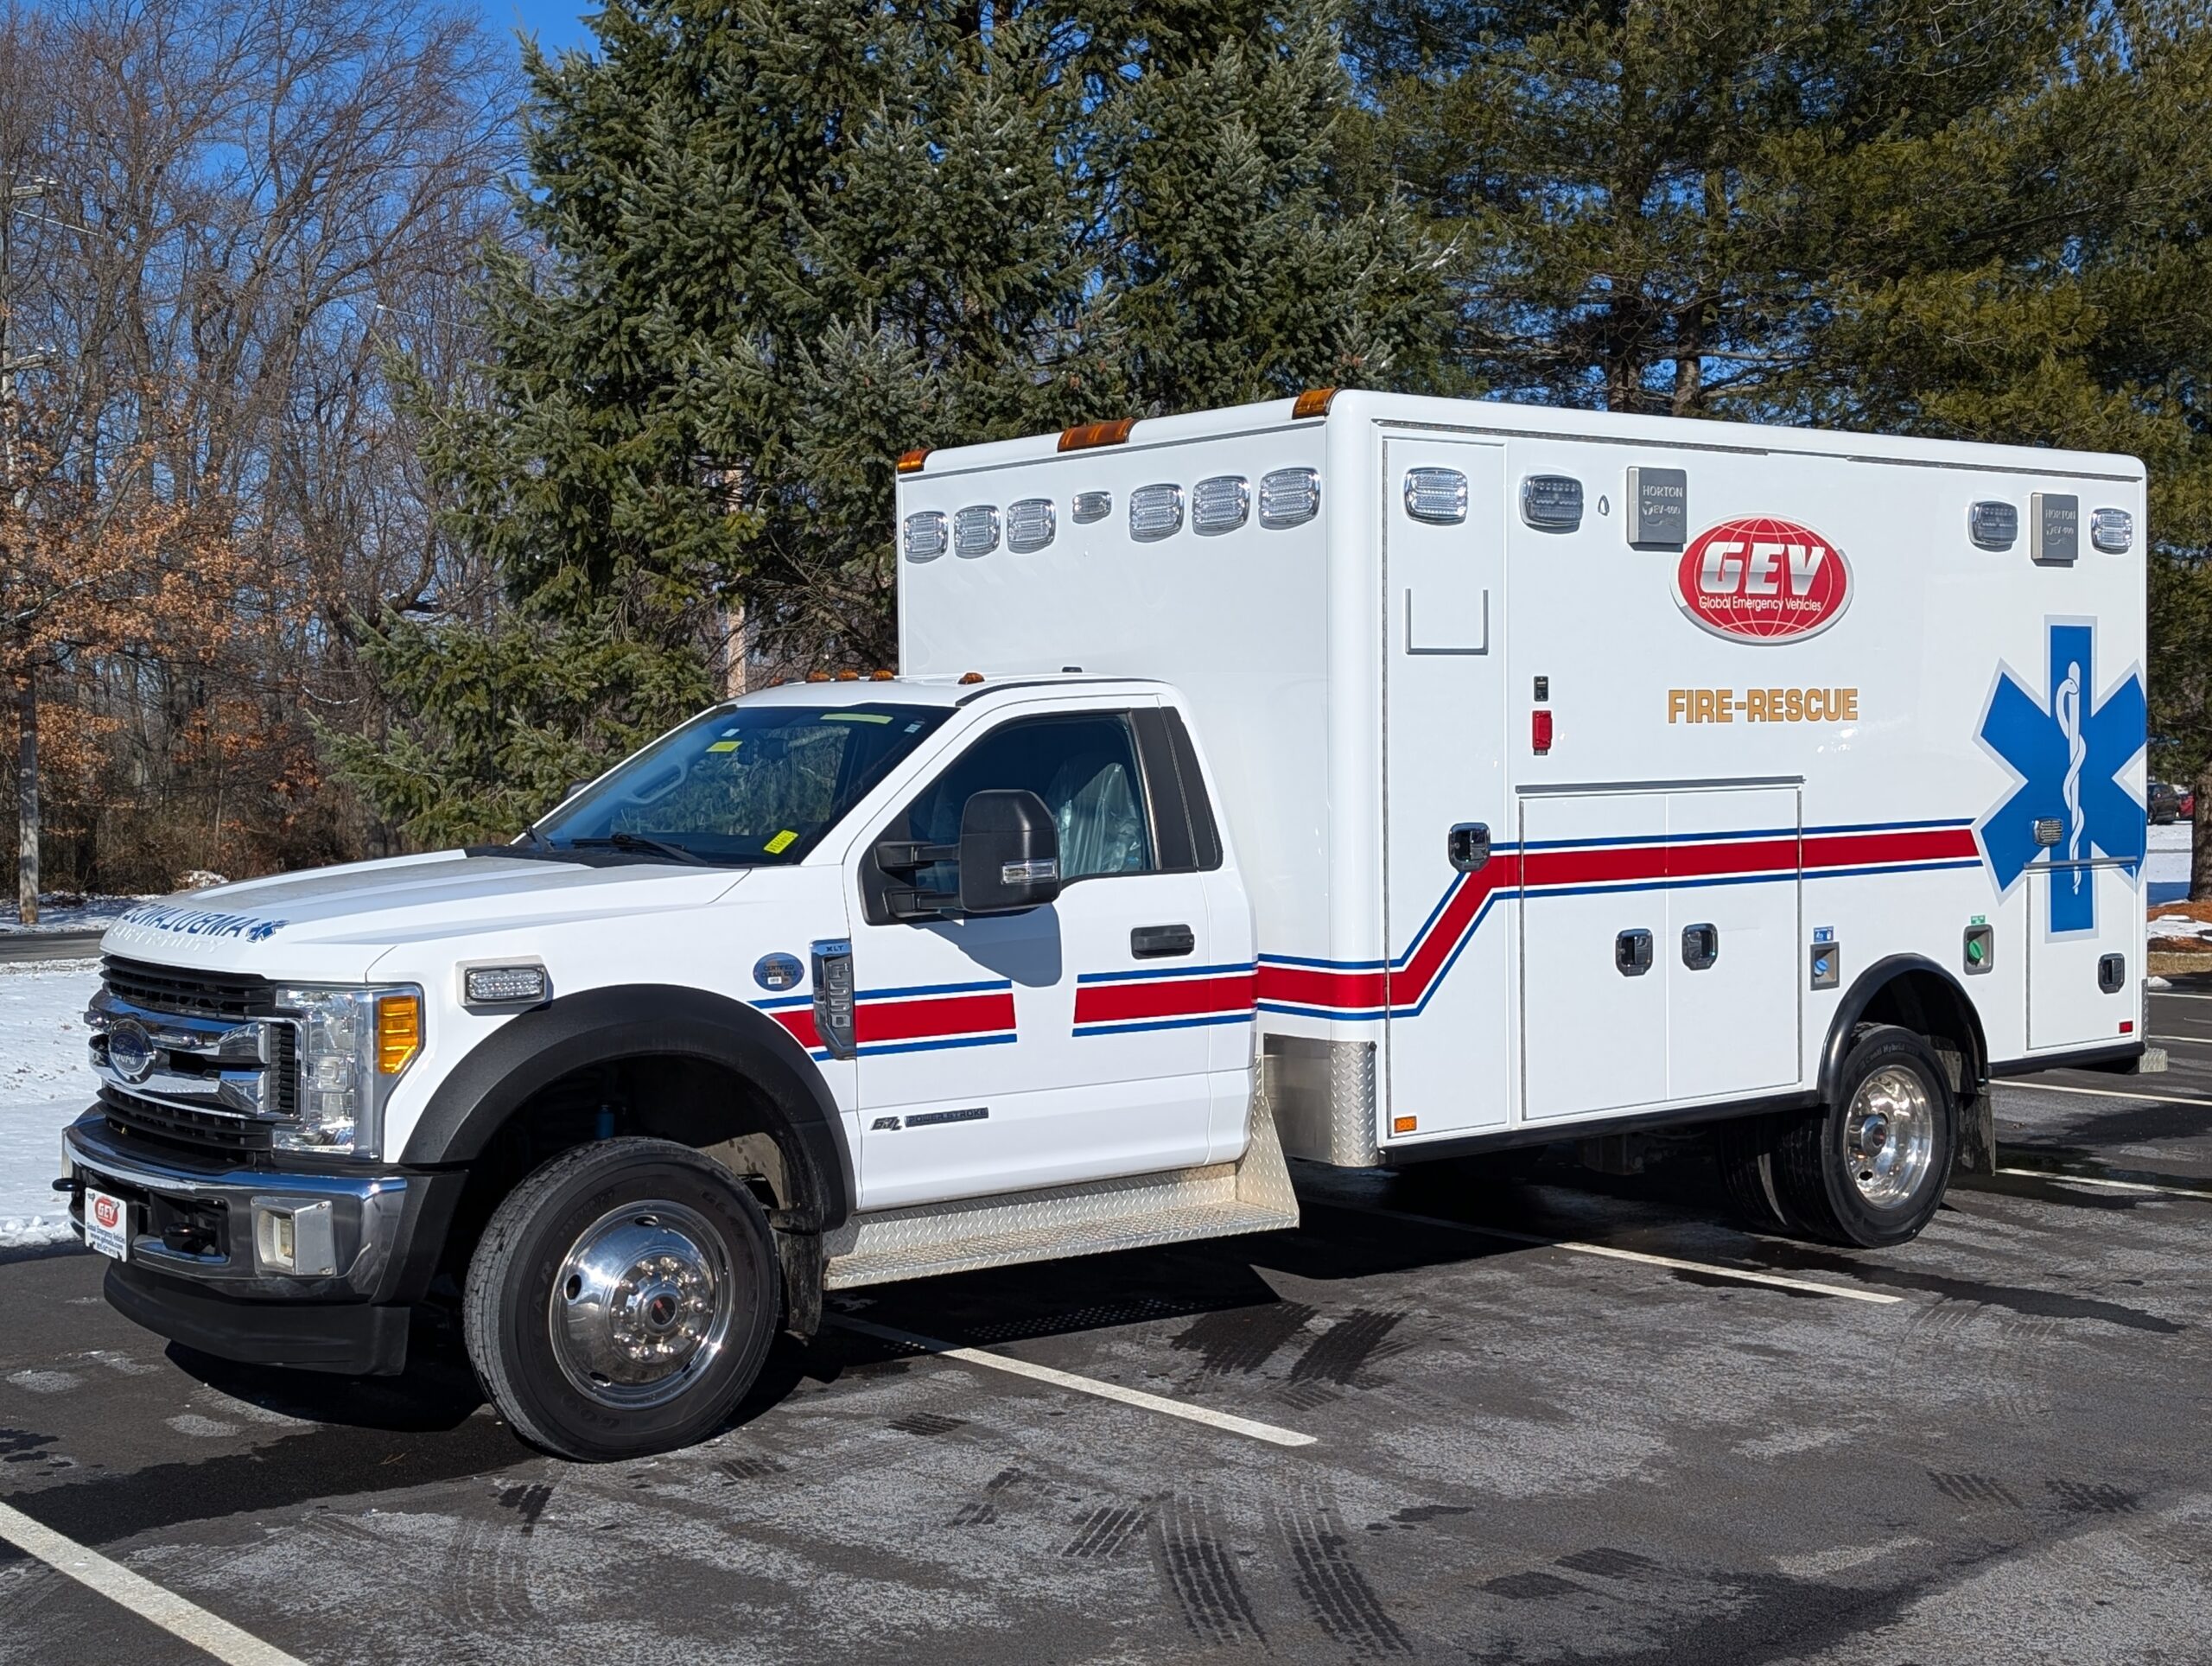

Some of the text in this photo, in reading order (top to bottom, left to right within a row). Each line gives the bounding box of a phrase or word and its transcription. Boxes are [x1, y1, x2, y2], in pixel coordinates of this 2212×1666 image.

[1643, 485, 1683, 498] HORTON
[2045, 508, 2076, 520] HORTON
[1700, 541, 1826, 596] GEV
[1699, 595, 1821, 613] Global Emergency Vehicles
[1668, 688, 1859, 724] FIRE-RESCUE
[97, 1202, 117, 1222] GEV
